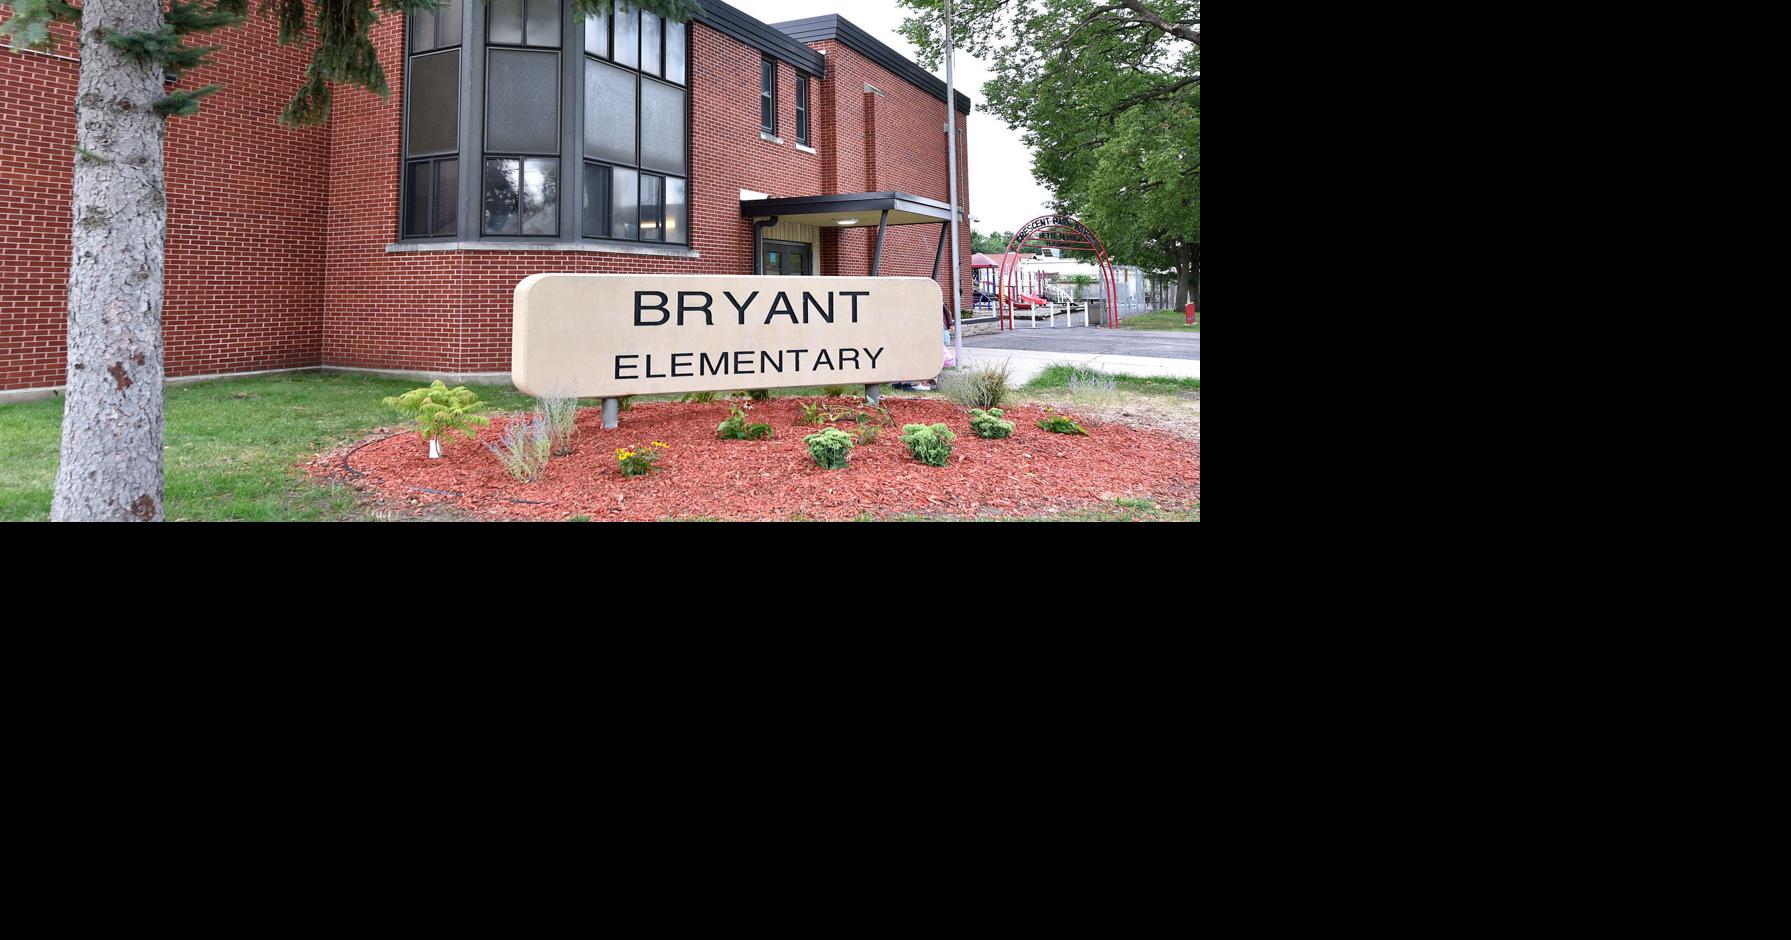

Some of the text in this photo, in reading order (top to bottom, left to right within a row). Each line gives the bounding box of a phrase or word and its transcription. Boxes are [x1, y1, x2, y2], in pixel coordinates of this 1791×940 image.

[1016, 217, 1050, 242] CRESCENT
[633, 290, 870, 327] BRYANT
[615, 347, 884, 380] ELEMENTARY
